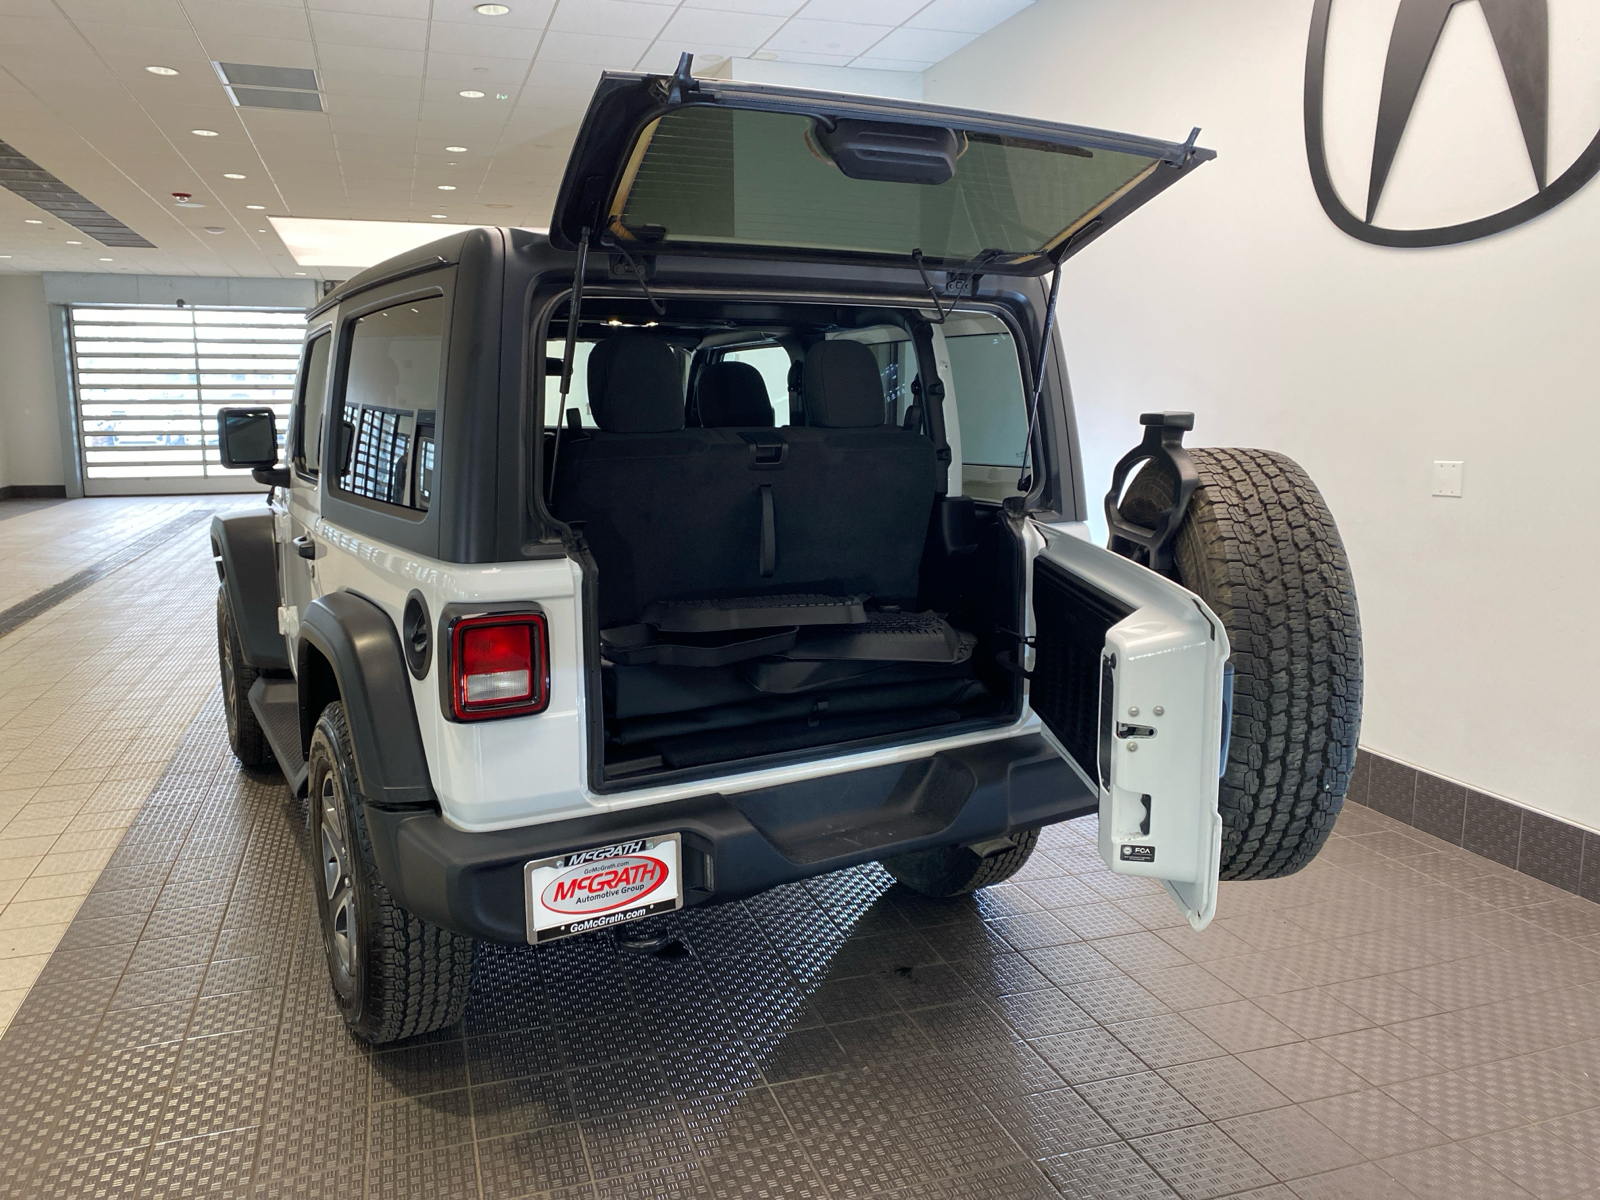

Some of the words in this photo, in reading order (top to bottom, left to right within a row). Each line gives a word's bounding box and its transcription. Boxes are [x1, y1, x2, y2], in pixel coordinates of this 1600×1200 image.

[584, 861, 629, 874] GoMcGrath.com
[575, 889, 619, 904] Automotive
[621, 884, 645, 894] Group
[570, 908, 646, 932] GoMcGrath.com
